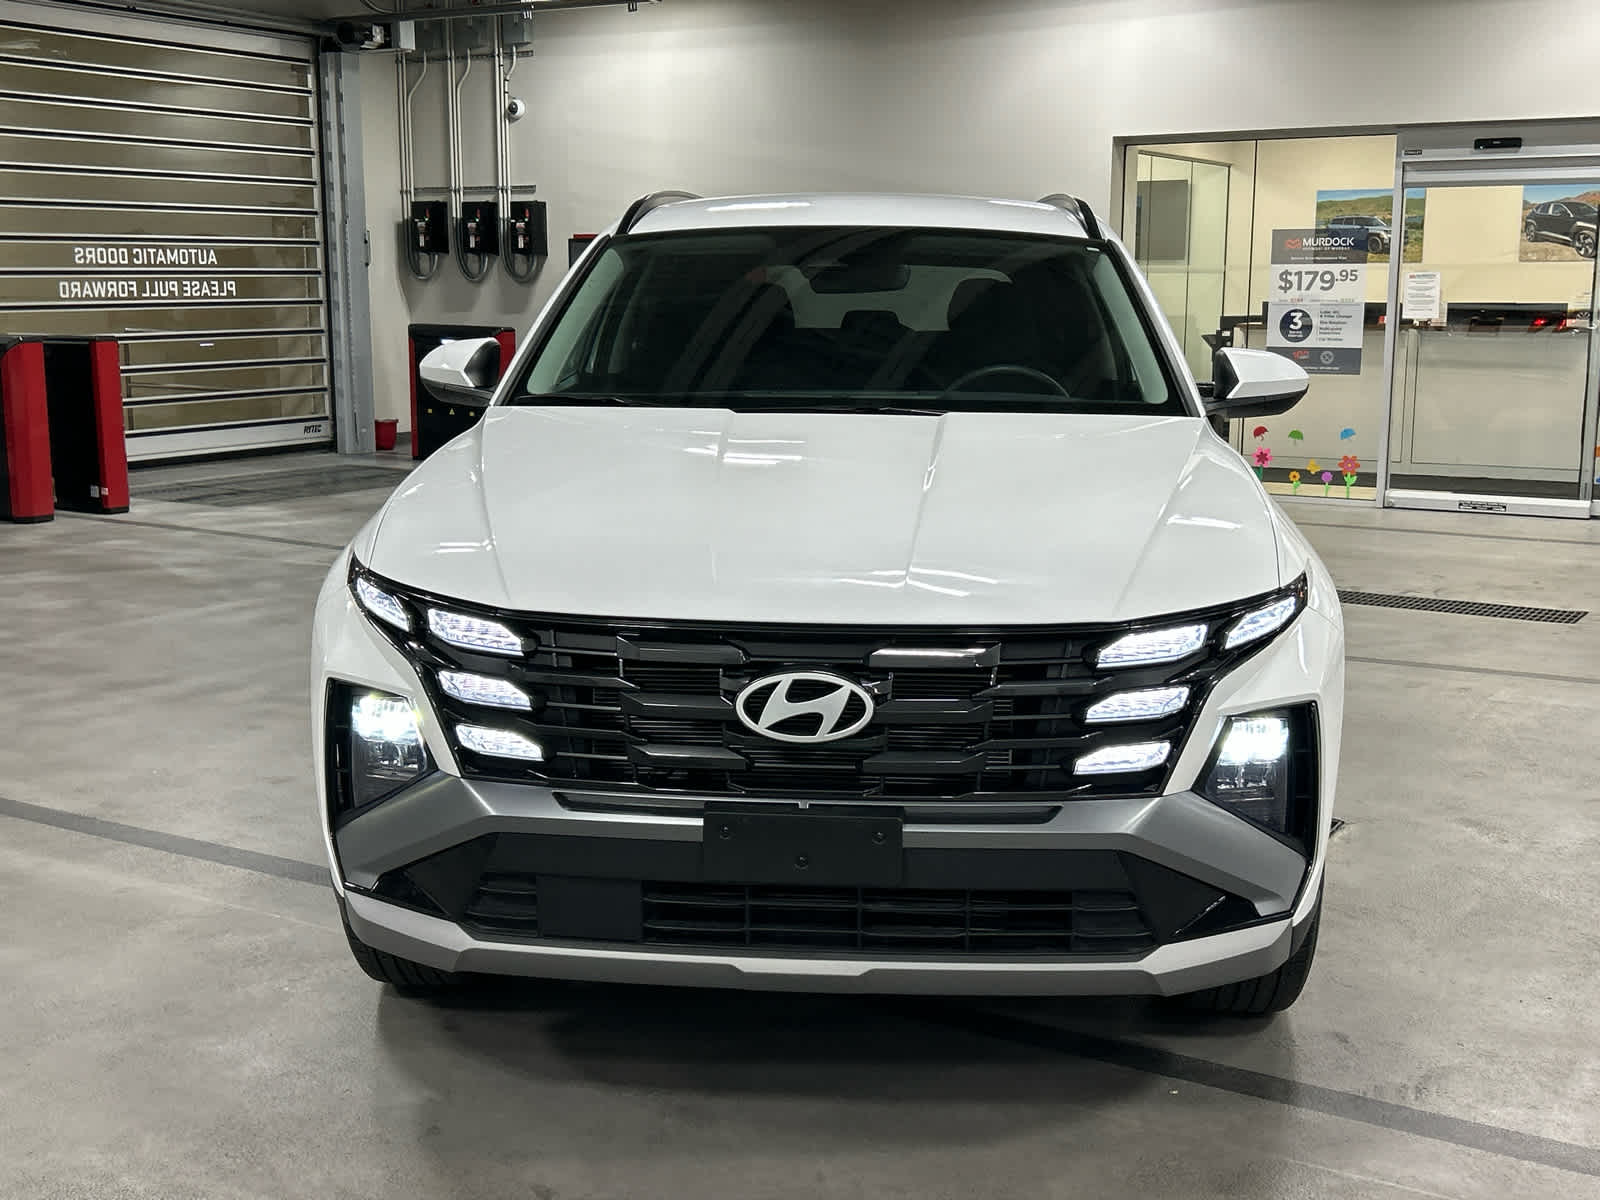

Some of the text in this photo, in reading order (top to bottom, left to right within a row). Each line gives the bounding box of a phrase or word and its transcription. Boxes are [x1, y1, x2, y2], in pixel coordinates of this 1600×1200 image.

[1302, 236, 1355, 247] MURDOCK
[1278, 269, 1359, 294] $179.95
[1289, 312, 1303, 330] 3
